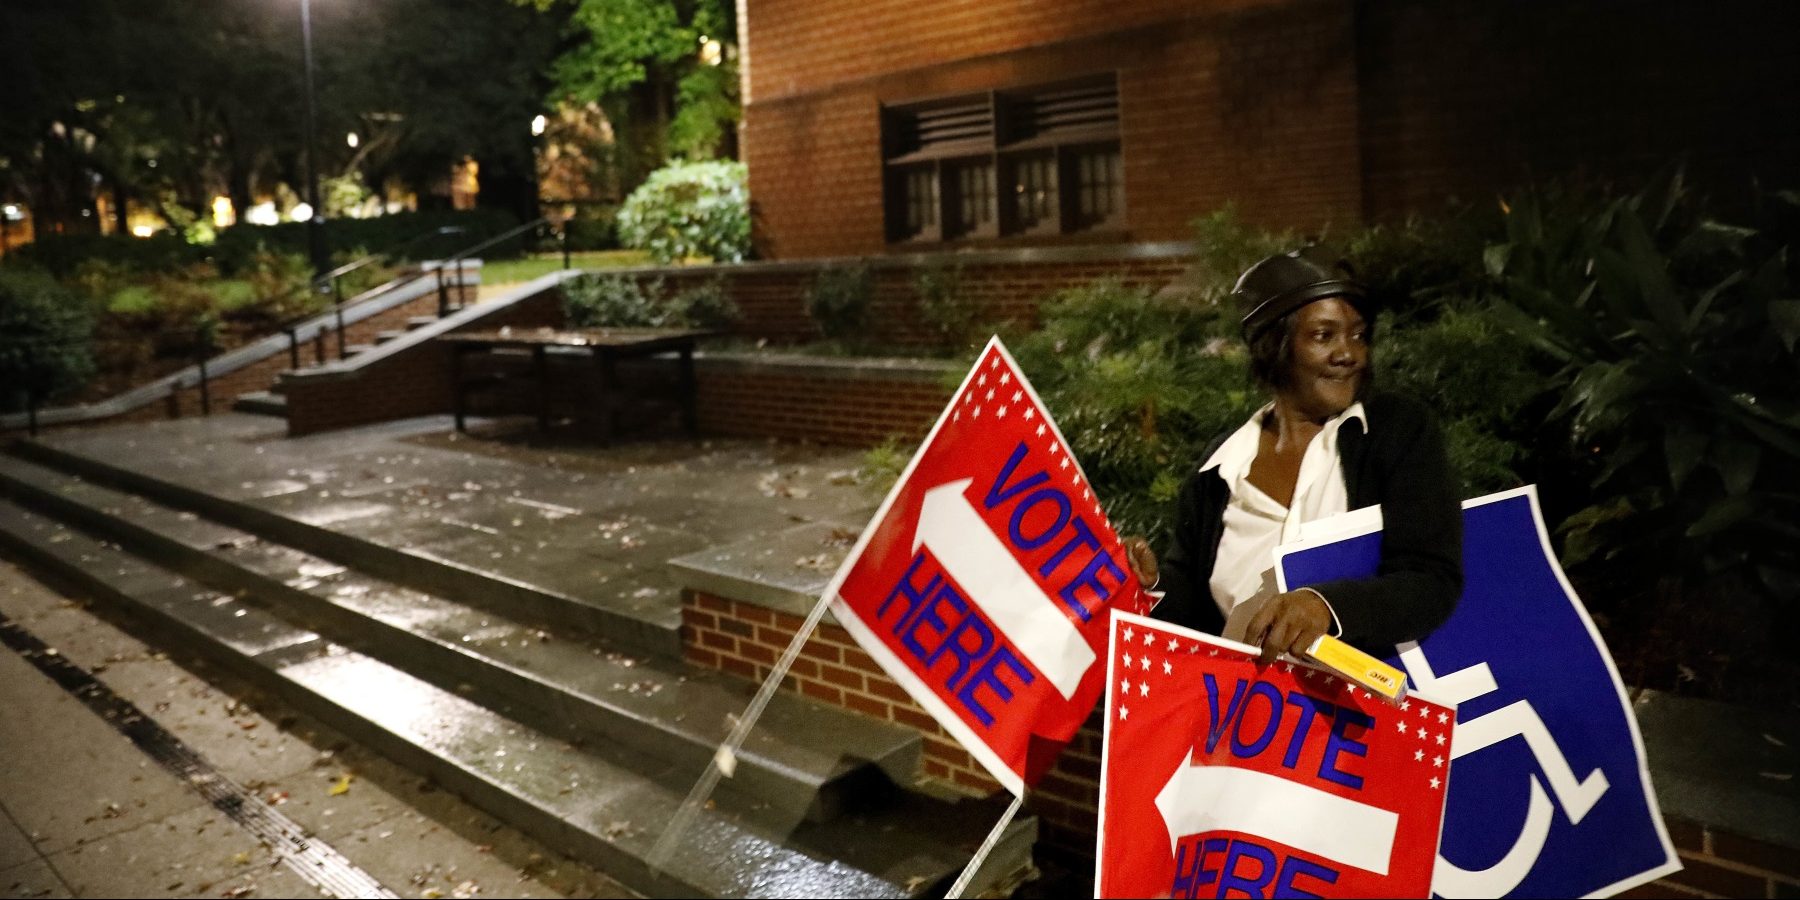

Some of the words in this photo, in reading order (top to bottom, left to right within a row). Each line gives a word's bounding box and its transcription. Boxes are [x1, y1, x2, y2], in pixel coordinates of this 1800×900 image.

[983, 441, 1128, 623] VOTE
[876, 552, 1035, 729] HERE
[1202, 672, 1376, 791] VOTE
